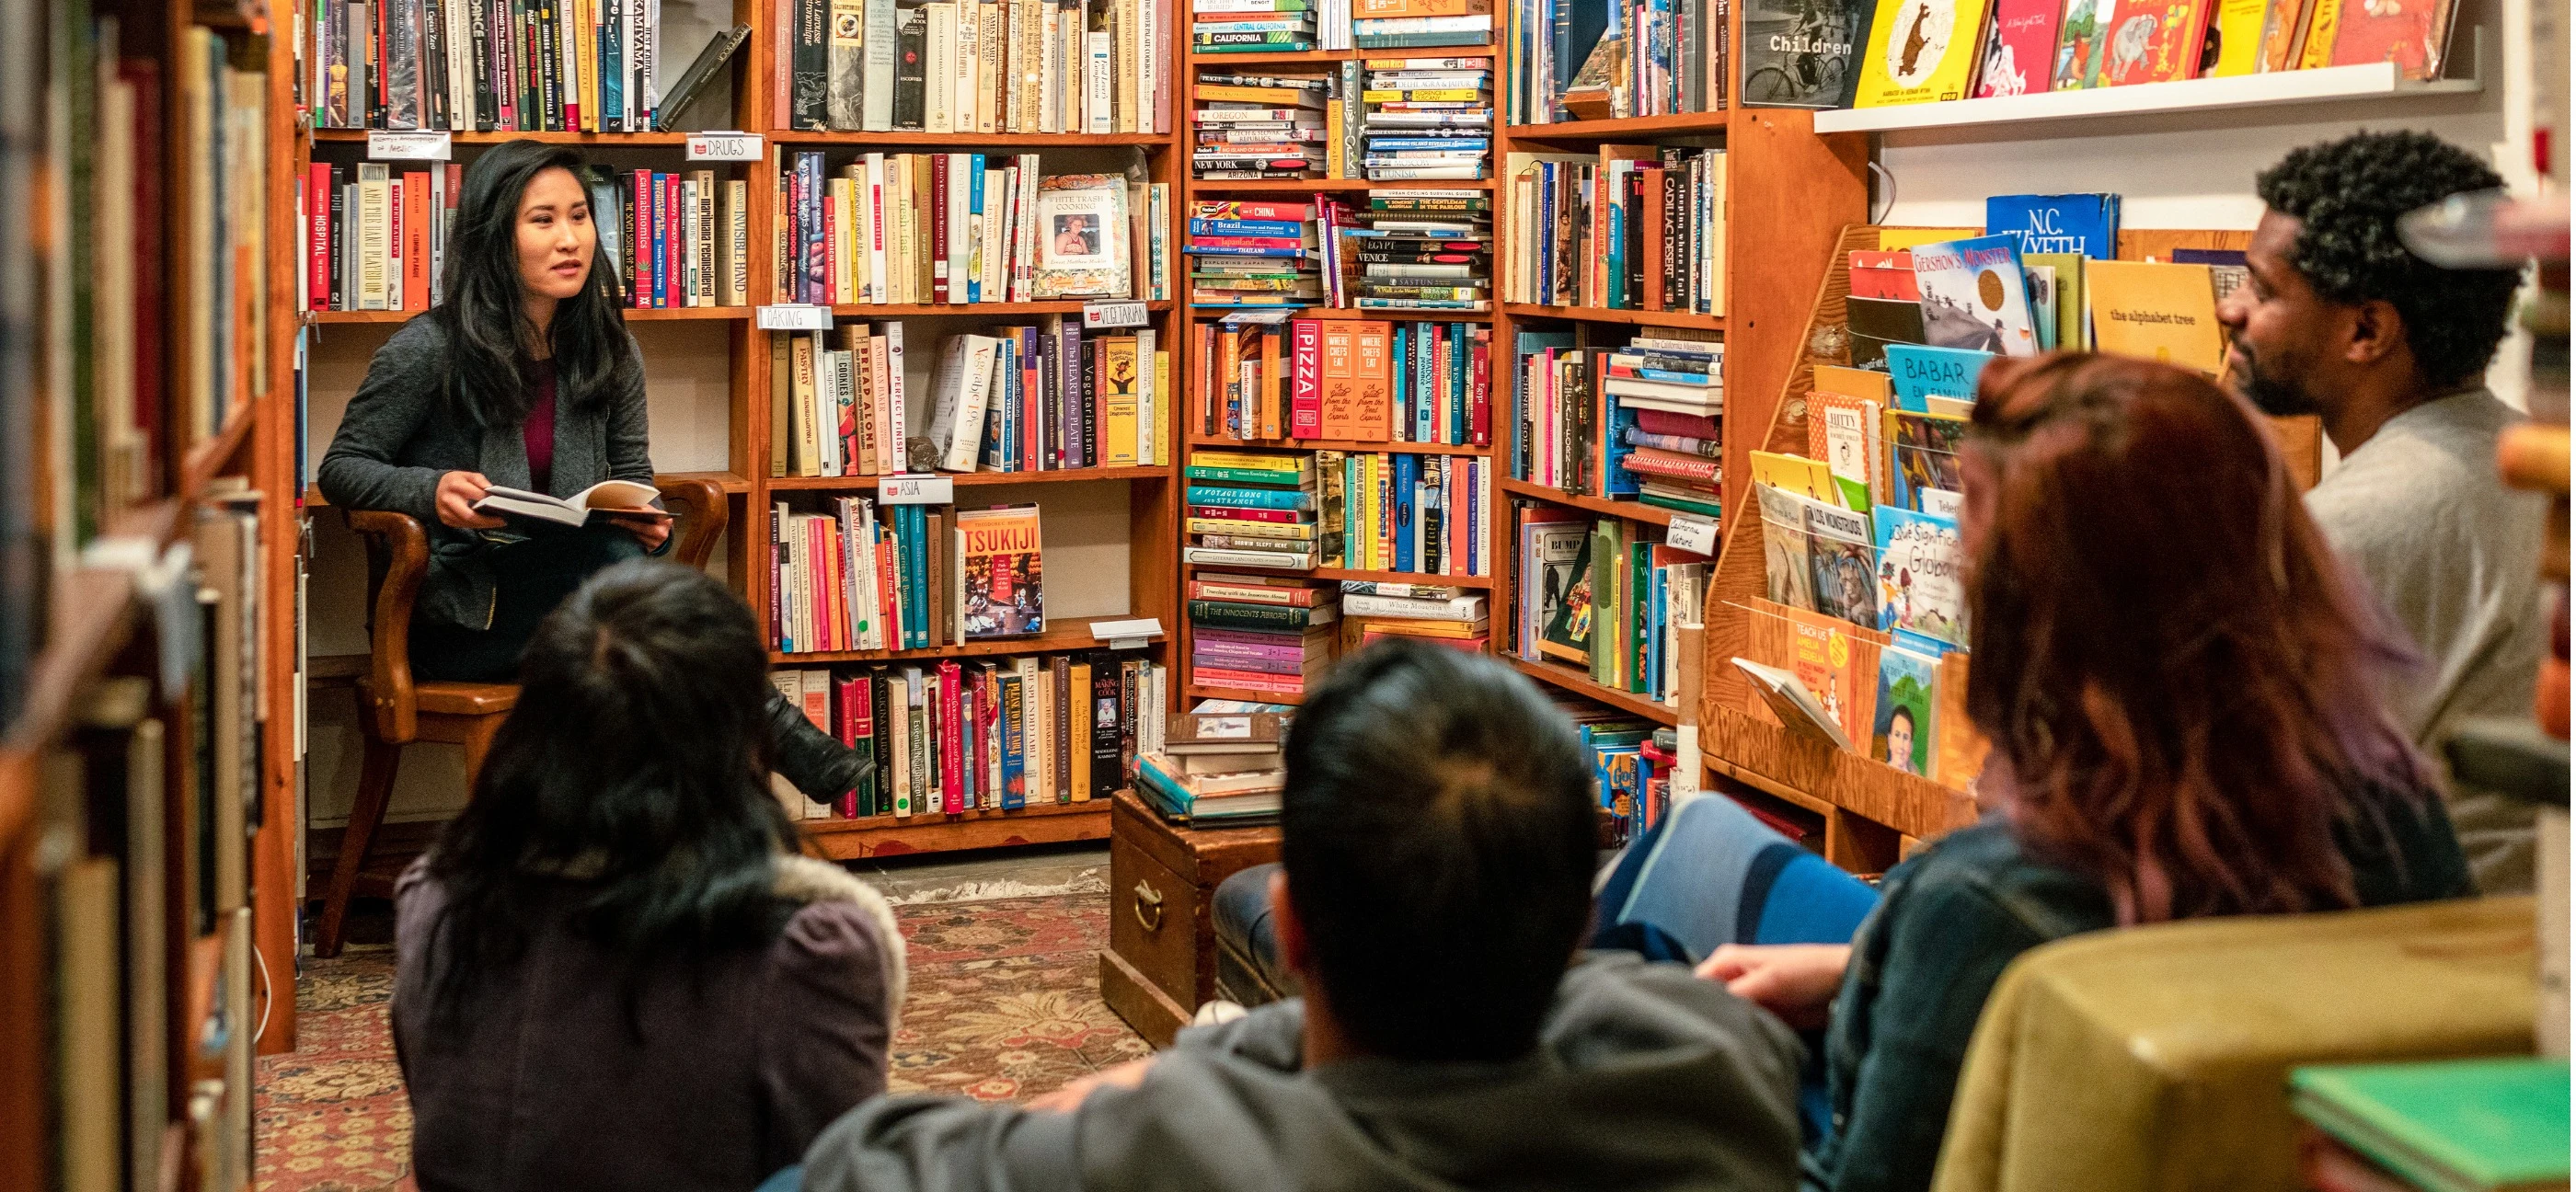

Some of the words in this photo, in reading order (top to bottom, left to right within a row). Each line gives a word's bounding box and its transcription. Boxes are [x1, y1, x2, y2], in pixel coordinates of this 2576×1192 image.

[427, 11, 435, 32] Captain
[635, 0, 643, 70] KAMIYAMA
[1770, 36, 1852, 55] Children
[708, 139, 744, 155] DRUGS
[1195, 161, 1213, 169] NEW
[1384, 169, 1417, 178] TUNISIA
[957, 163, 965, 196] create
[365, 188, 381, 204] AND
[1665, 178, 1674, 235] CADILLAC
[365, 207, 381, 223] THE
[640, 178, 650, 248] cannabinomics
[701, 199, 713, 240] marihuana
[900, 199, 909, 227] fresh
[1255, 208, 1275, 217] CHINA
[2029, 209, 2064, 235] N.C.
[316, 215, 326, 256] HOSPITAL
[365, 226, 381, 246] BAND
[734, 211, 745, 259] INVISIBLE
[901, 235, 910, 256] fast
[365, 251, 381, 279] PLAYED
[1359, 254, 1388, 262] VENICE
[1665, 237, 1673, 278] DESERT
[1915, 253, 1961, 275] GERSHON'S
[1965, 246, 2011, 268] MONSTER
[702, 244, 713, 296] reconsidered
[735, 262, 745, 292] HAND
[365, 283, 381, 292] ON
[767, 308, 802, 326] BAKING
[1099, 305, 1145, 324] VEGETARIAN
[2111, 310, 2127, 321] the
[2130, 310, 2172, 325] alphabet
[2174, 315, 2195, 325] tree
[1328, 337, 1348, 345] WHERE
[1362, 338, 1381, 346] WHERE
[1330, 348, 1347, 356] CHEFS
[1334, 358, 1343, 366] EAT
[1363, 349, 1380, 357] CHEFS
[861, 348, 870, 395] BREAD
[876, 345, 884, 384] AMERICAN
[1299, 335, 1314, 394] PIZZA
[1366, 359, 1375, 367] EAT
[1905, 358, 1969, 384] BABAR
[839, 362, 848, 395] COOKIES
[970, 348, 988, 400] Vegetable
[966, 405, 979, 427] Love
[1084, 366, 1094, 453] Vegetarianism
[1830, 413, 1856, 427] HITTY
[864, 402, 873, 450] ALONE
[900, 482, 920, 496] ASIA
[1671, 520, 1699, 534] California
[1825, 511, 1861, 536] MONSTRUOS
[965, 528, 1035, 552] TSUKIJI
[1670, 533, 1692, 547] Nature
[1797, 624, 1816, 637] TEACH
[1818, 630, 1826, 641] US
[913, 721, 921, 751] Essential
